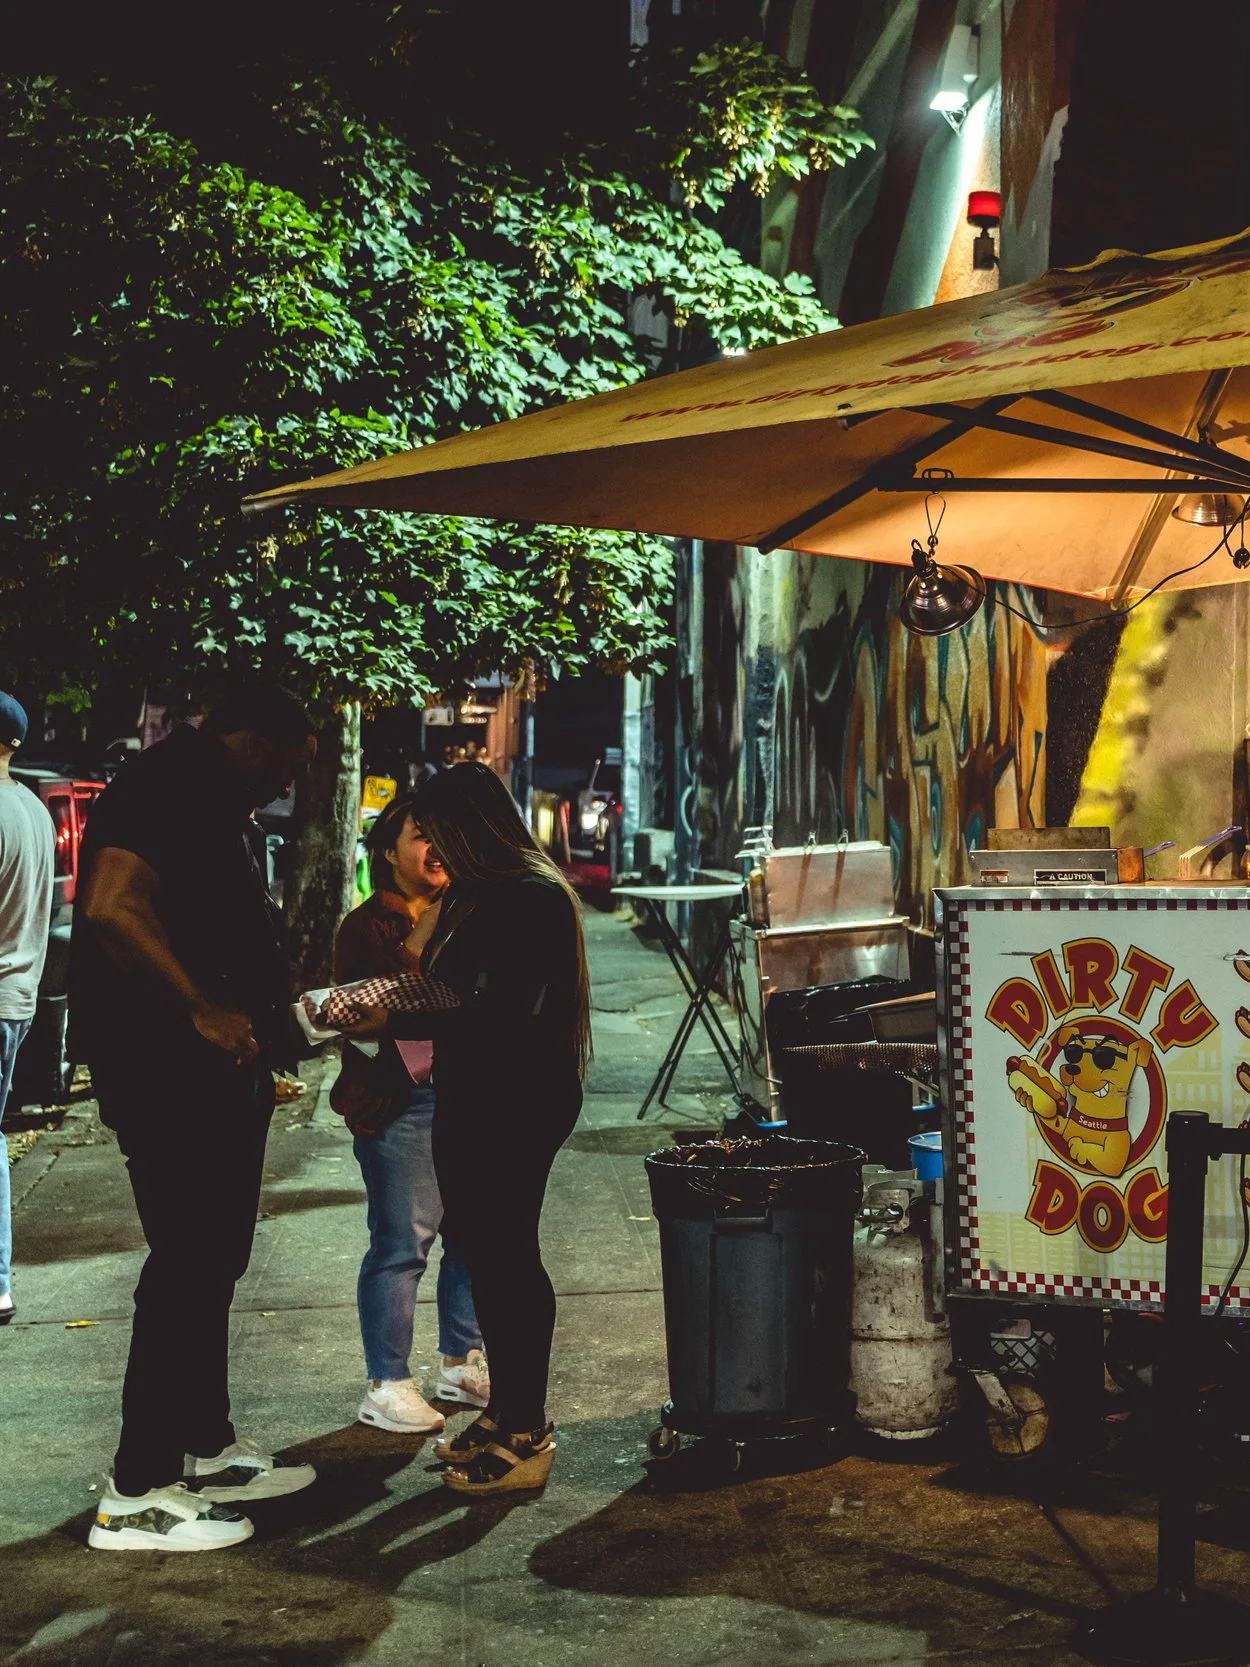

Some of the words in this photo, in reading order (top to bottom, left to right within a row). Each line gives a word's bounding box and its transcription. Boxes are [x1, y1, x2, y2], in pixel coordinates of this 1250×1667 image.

[1057, 873, 1093, 881] CAUTION
[985, 937, 1219, 1054] DIRTY
[1078, 1115, 1108, 1130] Seattle
[1025, 1159, 1169, 1253] DOG
